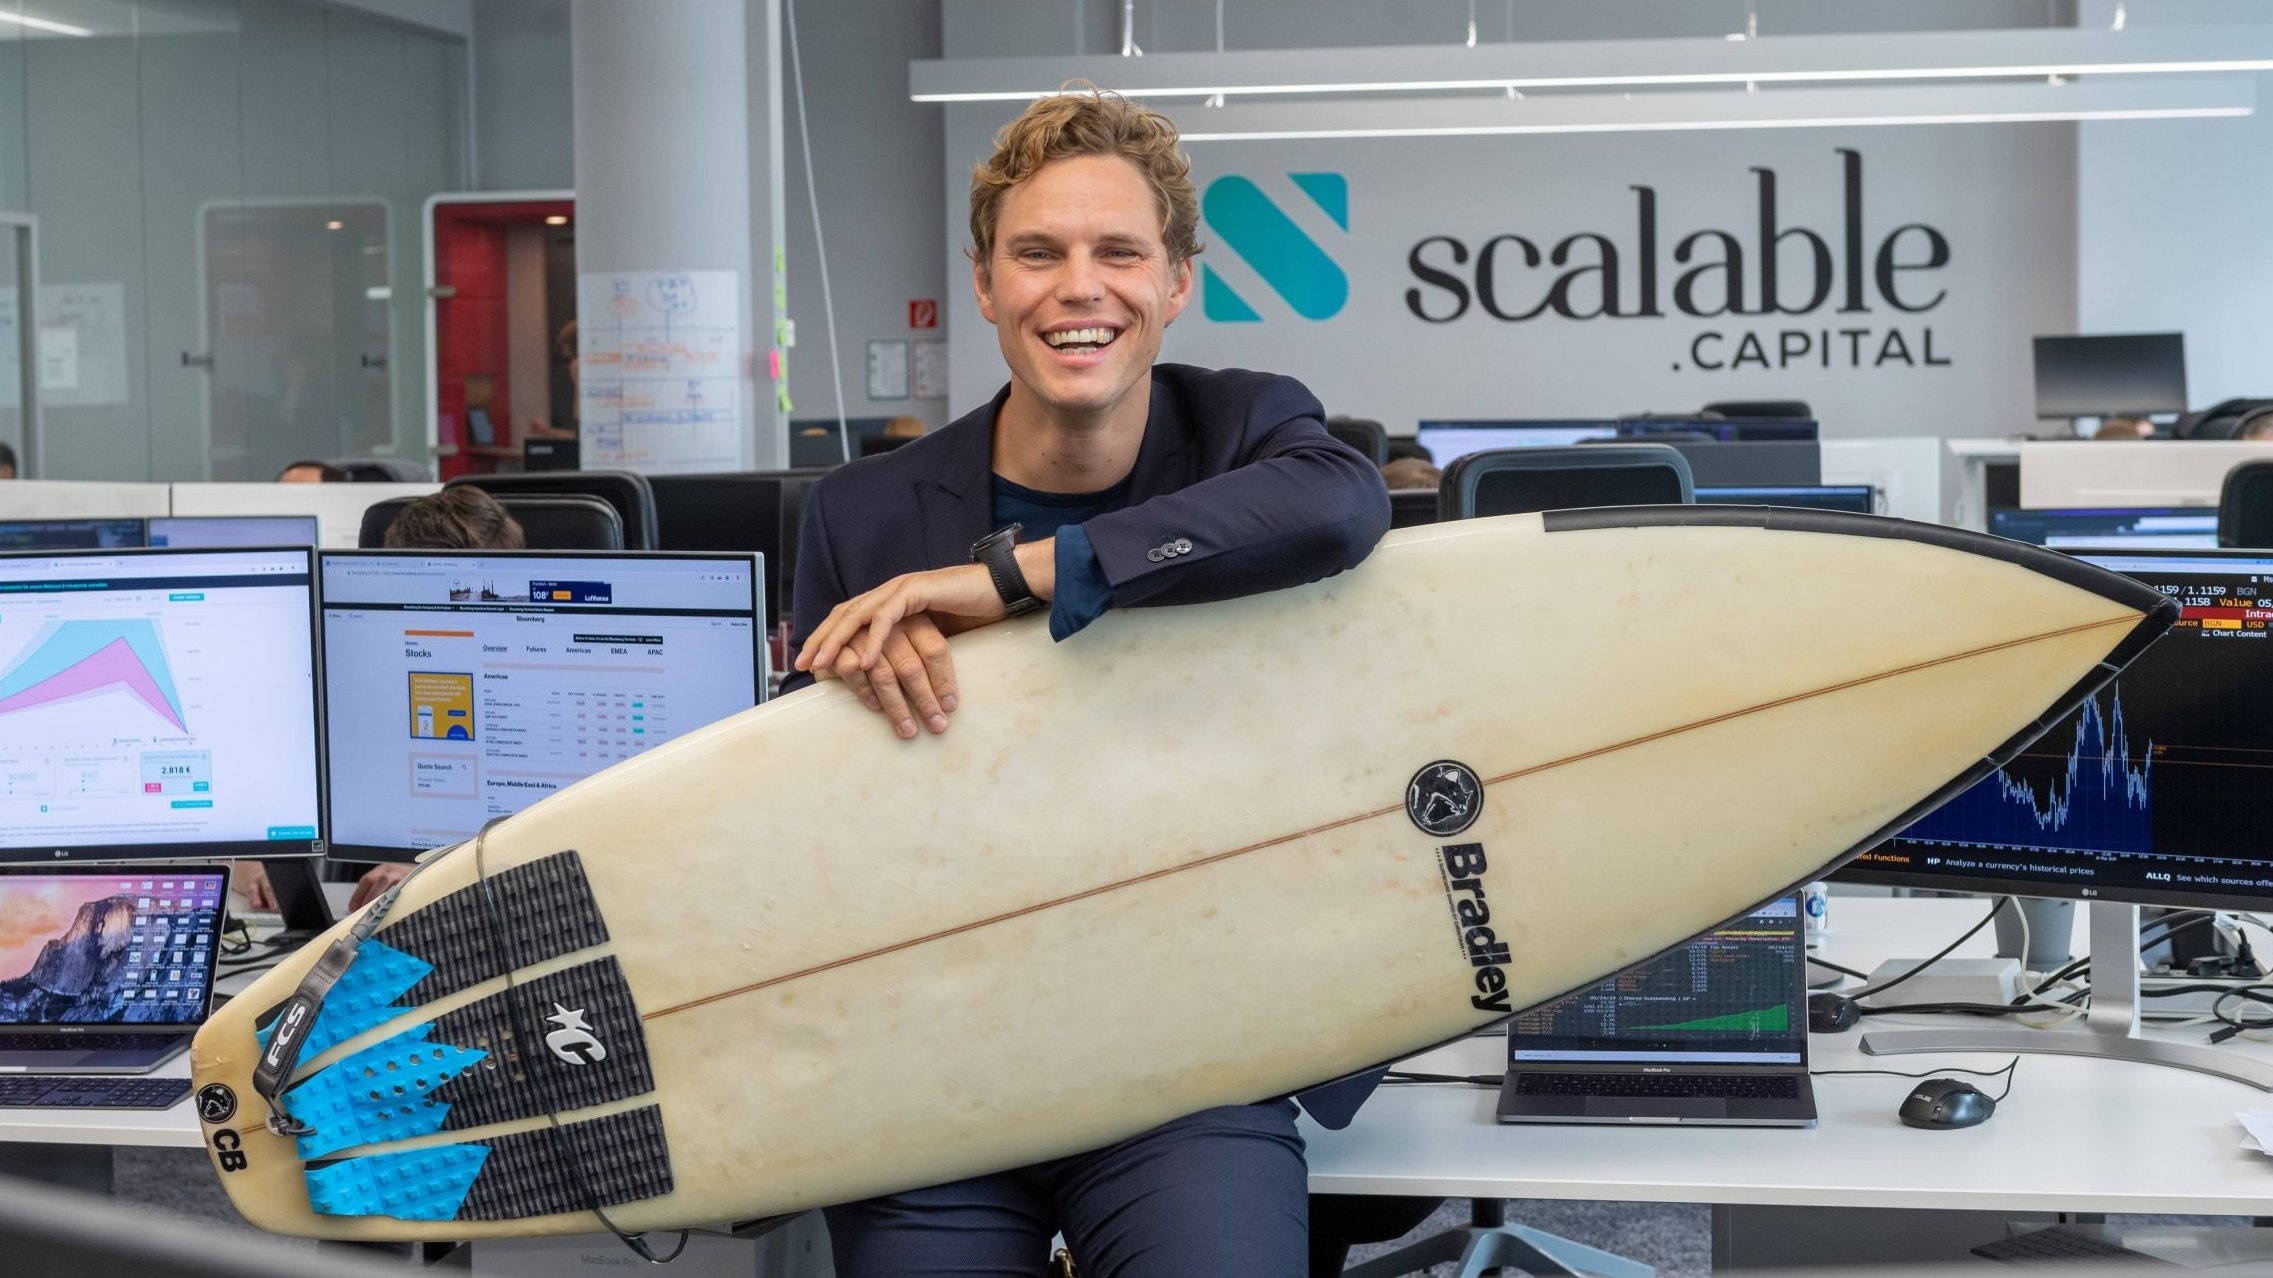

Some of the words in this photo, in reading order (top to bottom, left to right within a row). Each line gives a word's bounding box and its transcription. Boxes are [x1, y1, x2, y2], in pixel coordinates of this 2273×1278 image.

[1404, 147, 1951, 323] scalable
[1672, 327, 1952, 372] .CAPITAL
[2236, 587, 2257, 596] BGN
[585, 594, 609, 602] Lufthansa
[2219, 598, 2253, 608] Value
[516, 616, 545, 624] Bloomberg
[2204, 619, 2222, 627] BGN
[2246, 620, 2265, 628] USD
[2236, 630, 2267, 638] Content
[405, 648, 432, 658] Stocks
[483, 645, 507, 653] Overview
[434, 763, 453, 771] Search
[1874, 854, 1910, 863] Functions
[1927, 857, 1941, 866] HP
[1946, 858, 1976, 868] Analyze
[1986, 862, 2027, 872] currency's
[2030, 864, 2068, 873] historical
[2069, 867, 2095, 876] prices
[2146, 872, 2171, 881] ALLQ
[2177, 874, 2192, 882] See
[2194, 875, 2219, 884] which
[2221, 878, 2254, 886] sources
[1442, 842, 1512, 1013] Bradley
[266, 1003, 306, 1067] FCS
[213, 1127, 247, 1173] CB
[580, 1254, 620, 1267] MacBook
[623, 1257, 638, 1269] Pro
